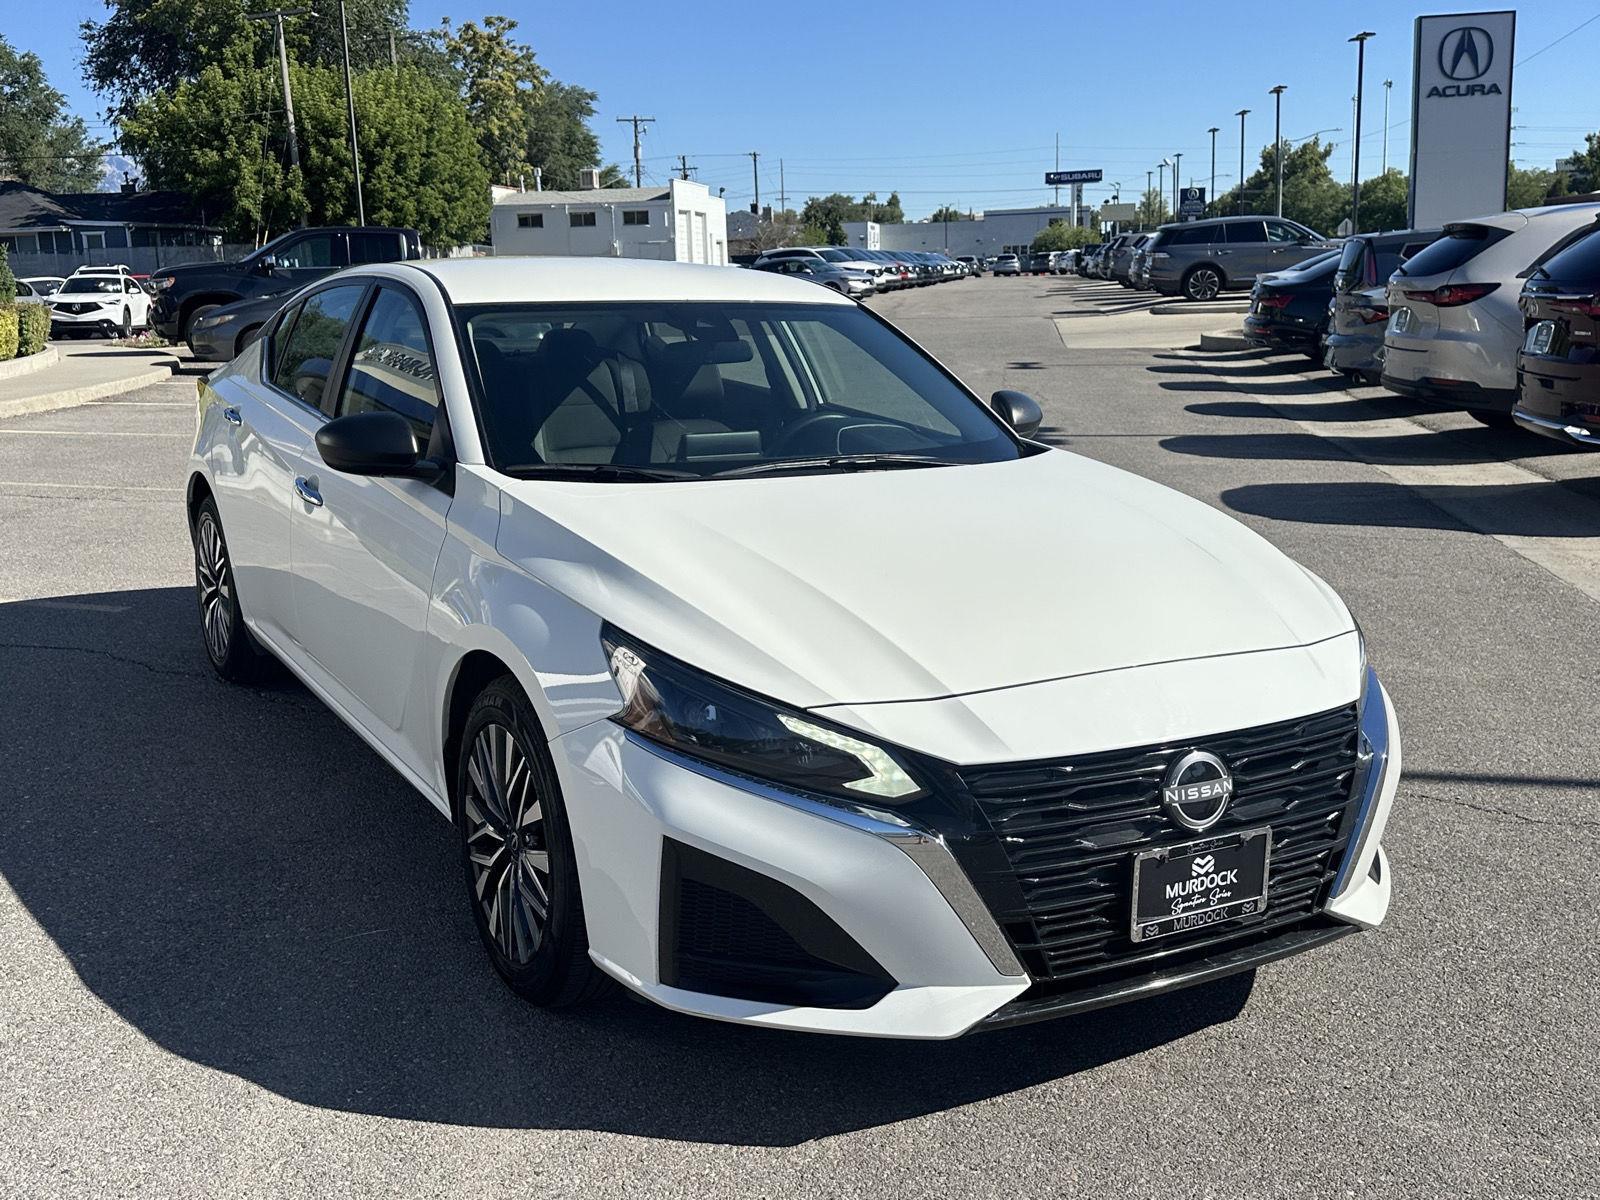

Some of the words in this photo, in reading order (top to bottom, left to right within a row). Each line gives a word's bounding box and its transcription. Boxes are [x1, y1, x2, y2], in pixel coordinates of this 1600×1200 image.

[1426, 83, 1502, 98] ACURA
[1060, 172, 1101, 180] SUBARU
[1165, 779, 1232, 801] NISSAN
[1165, 869, 1237, 899] MURDOCK
[1171, 894, 1206, 915] Signature
[1209, 888, 1231, 905] Series
[1173, 907, 1228, 930] MURDOCK
